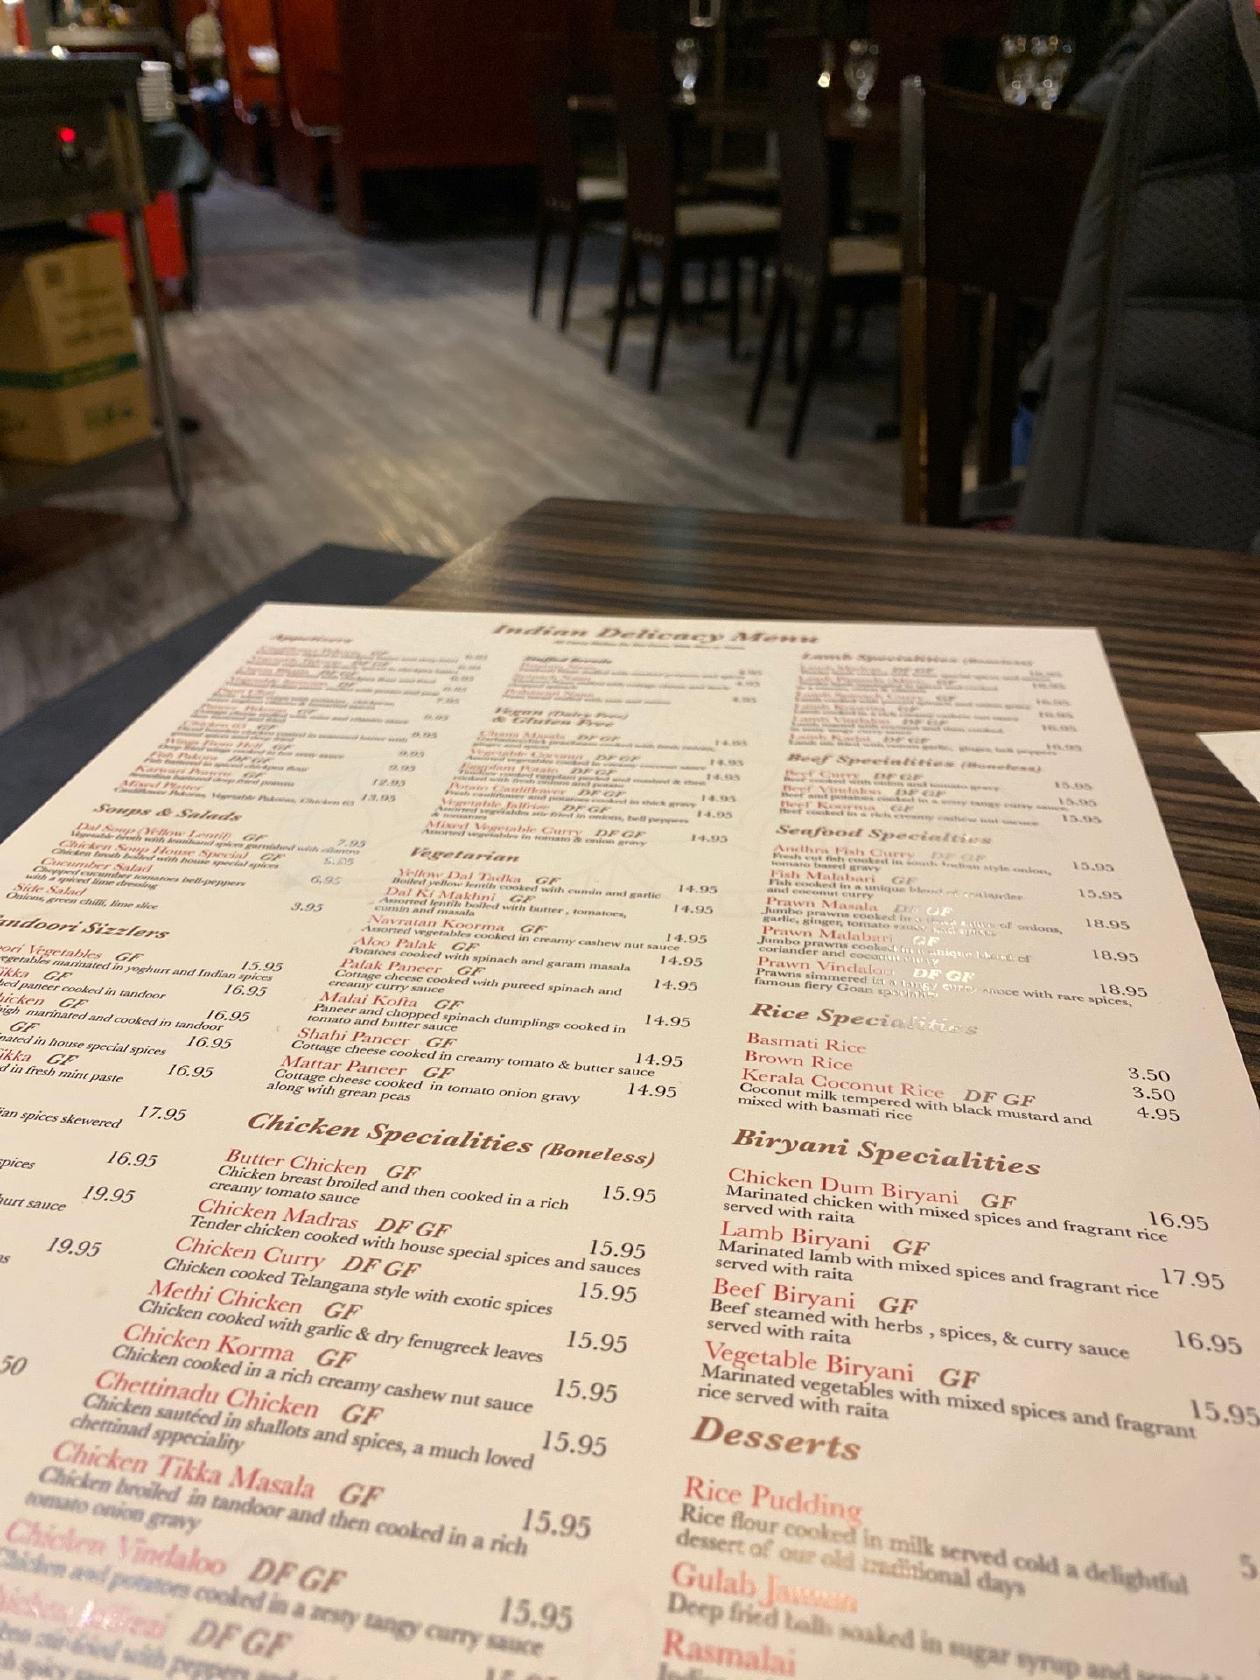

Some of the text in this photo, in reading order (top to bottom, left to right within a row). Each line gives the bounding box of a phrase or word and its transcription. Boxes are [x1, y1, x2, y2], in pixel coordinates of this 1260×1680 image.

[491, 623, 819, 645] Indian Delicacy Menu
[92, 803, 243, 822] Soups & Salads
[775, 824, 865, 838] Seafood
[409, 846, 520, 863] Vegetarian
[13, 882, 325, 913] Side Salad 3.95
[445, 870, 474, 881] Dal
[478, 871, 522, 884] Tadka
[535, 875, 562, 886] GF
[678, 884, 719, 894] 14.95
[770, 869, 1123, 901] Fish Malabari GF 15.95
[0, 914, 171, 940] andoori Sizzlers
[29, 944, 284, 972] Vegetables GF 15.95
[318, 990, 691, 1028] Malai Kofta GF 14.95
[750, 1002, 810, 1022] Rice
[9, 1020, 233, 1050] GF 16.95
[32, 1035, 167, 1056] in house special spices
[297, 1026, 683, 1068] Shahi Paneer GF 14.95
[46, 1053, 215, 1079] GF 16.95
[279, 1054, 677, 1099] Mattar Paneer GF 14.95
[290, 1039, 656, 1078] Cottage cheese cooked in creamy tomato & butter sauce
[744, 1049, 1176, 1103] Brown Rice 3.50
[746, 1031, 1171, 1083] Basmati Rice 3.50
[137, 1105, 187, 1122] 17.95
[739, 1082, 1093, 1126] Coconut milk tempered with black mustard and
[741, 1067, 1181, 1122] Kerala Coconut Rice DF GF 4.95
[19, 1112, 124, 1129] spices skewered
[106, 1150, 159, 1168] 16.95
[247, 1112, 655, 1169] Chicken Specialities (Boneless)
[731, 1128, 1041, 1176] Biryani Specialities
[81, 1185, 137, 1204] 19.95
[208, 1181, 361, 1205] creamy tomato sauce
[224, 1148, 656, 1204] Butter Chicken GF 15.95
[723, 1202, 855, 1224] served with raita
[725, 1184, 1168, 1243] Marinated chicken with mixed spices and fragrant rice
[728, 1167, 1209, 1231] Chicken Dum Biryani GF 16.95
[45, 1236, 103, 1258] 19.95
[189, 1214, 641, 1277] Tender chicken cooked with house special spices and sauces
[198, 1198, 646, 1260] Chicken Madras DF GF 15.95
[175, 1235, 637, 1304] Chicken Curry DF GF 15.95
[719, 1220, 1225, 1291] Lamb Biryani GF 17.95
[712, 1277, 1243, 1355] Beef Biryani GF 16.95
[123, 1323, 618, 1404] Chicken Korma GF 15.95
[95, 1369, 607, 1458] Chettinadu Chicken GF 15.95
[689, 1415, 861, 1461] Desserts
[52, 1439, 592, 1541] Chicken Tikka Masala GF 15.95
[682, 1475, 863, 1528] Rice Pudding
